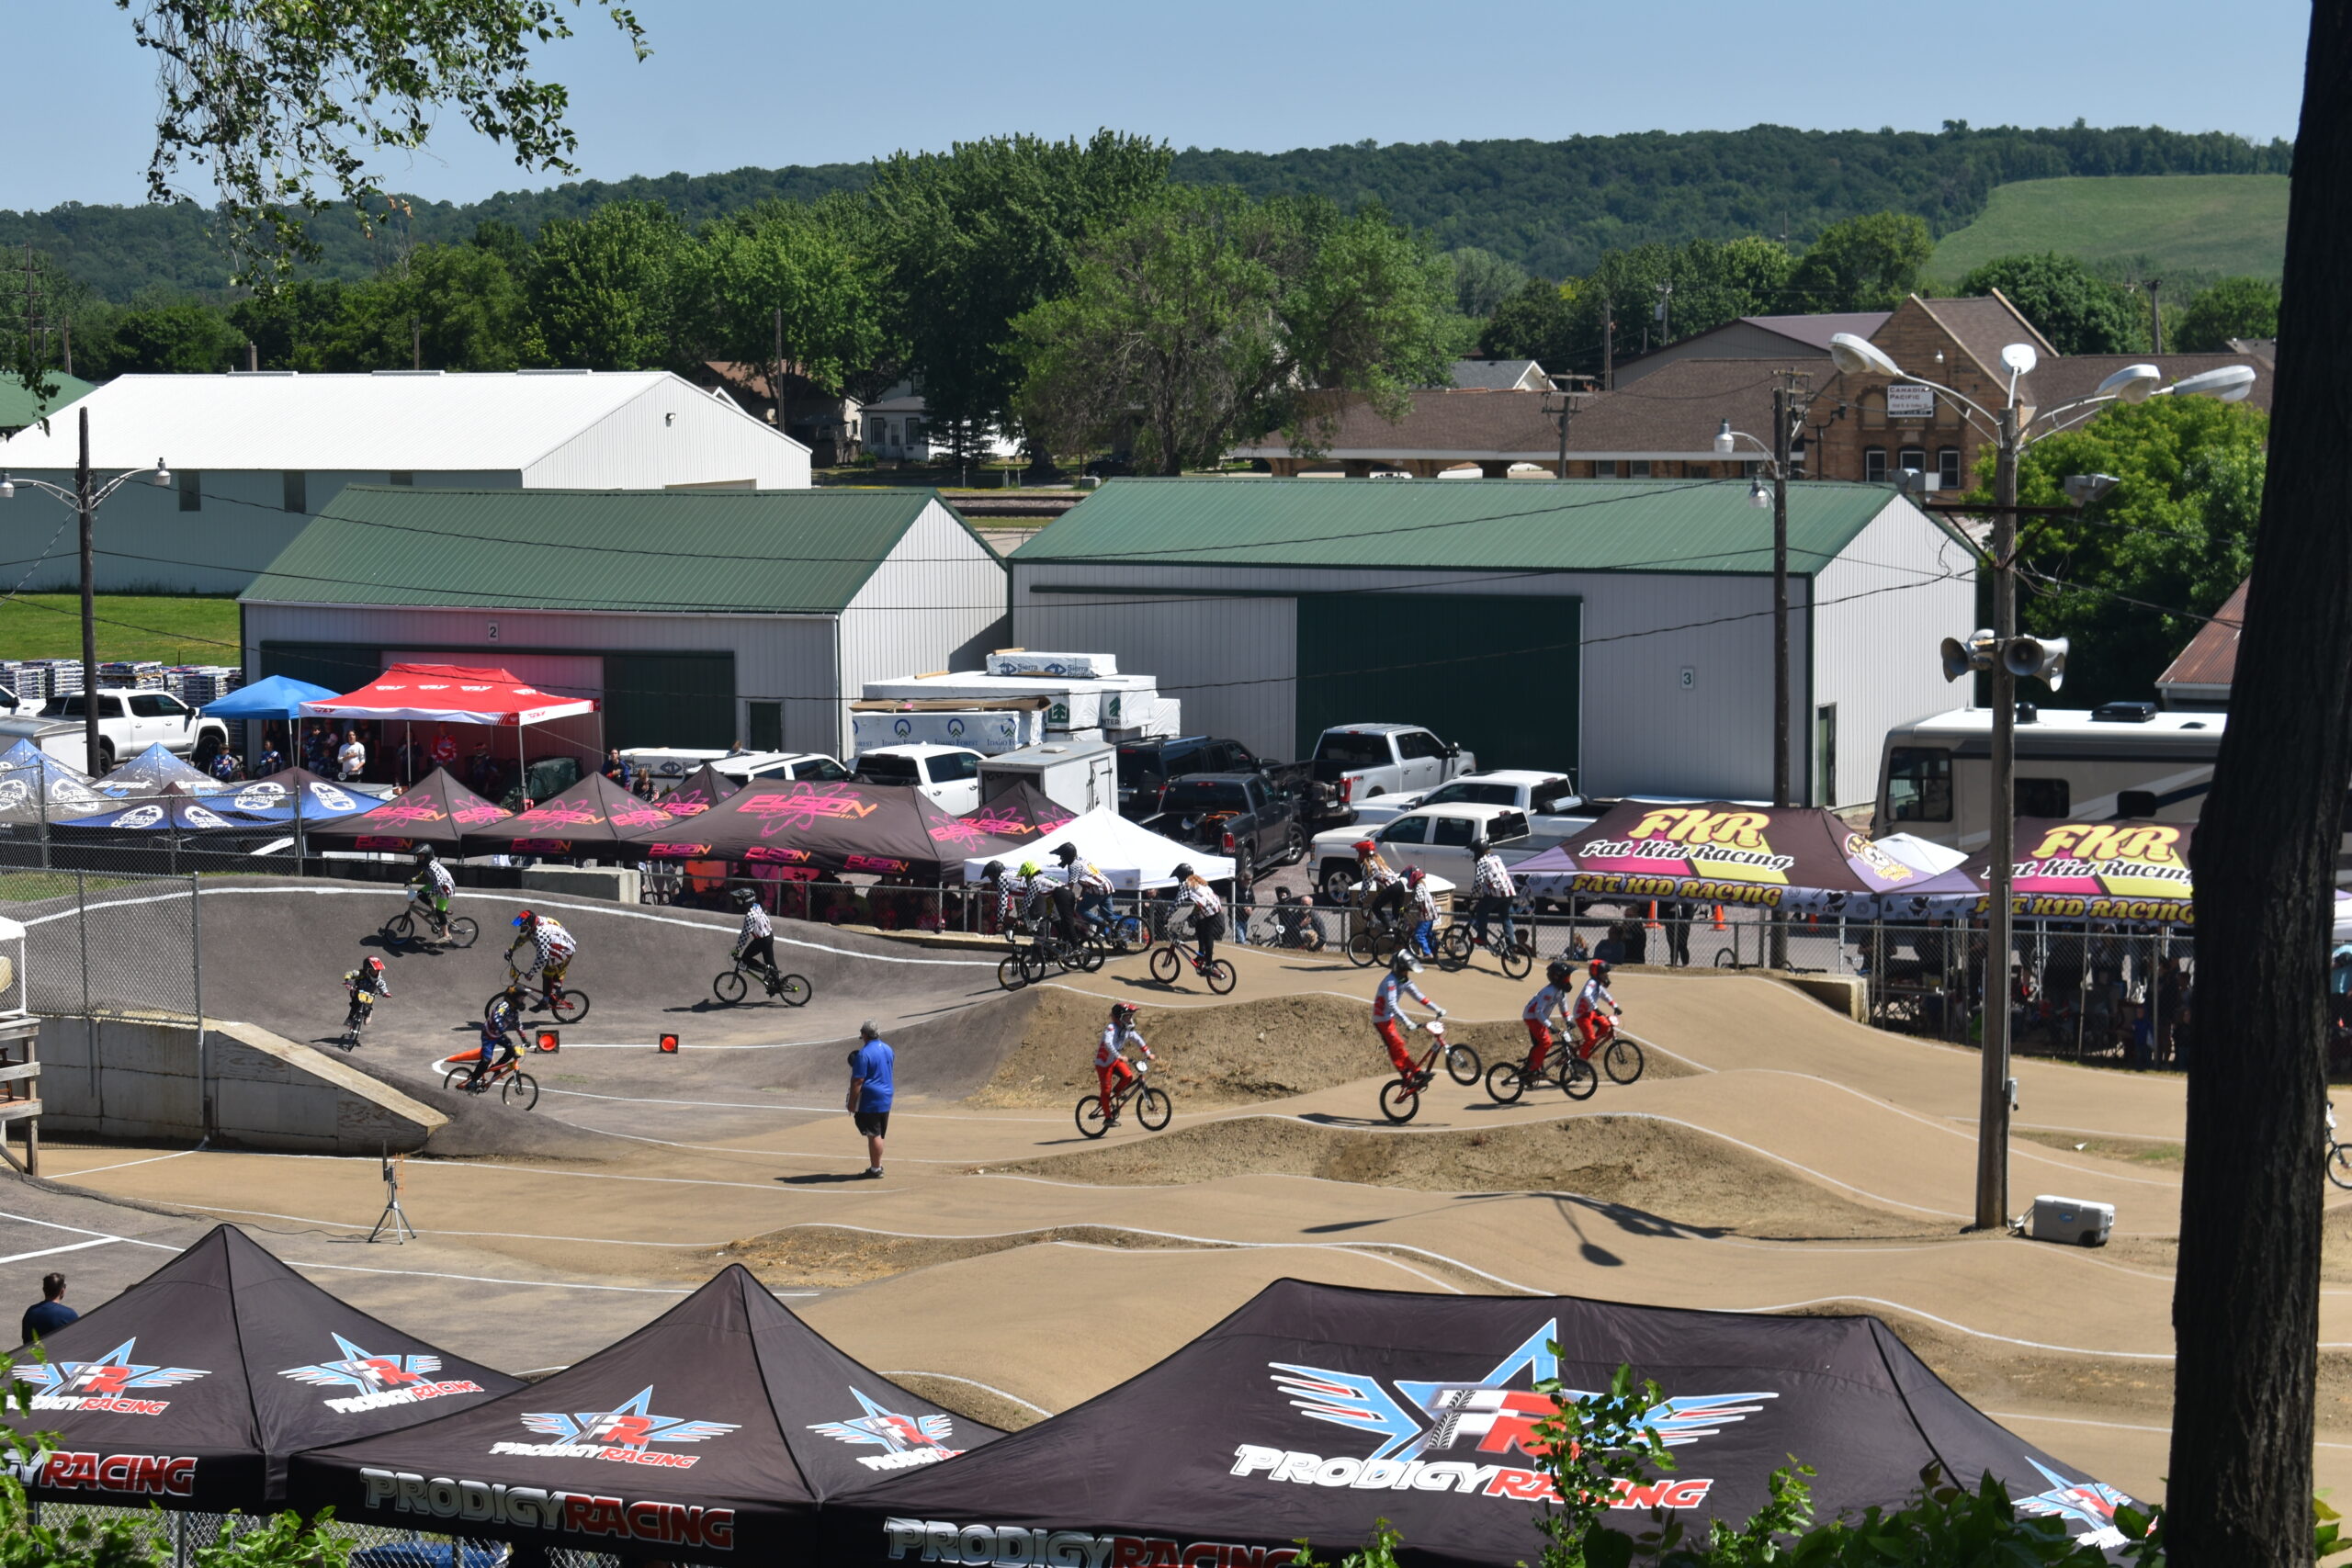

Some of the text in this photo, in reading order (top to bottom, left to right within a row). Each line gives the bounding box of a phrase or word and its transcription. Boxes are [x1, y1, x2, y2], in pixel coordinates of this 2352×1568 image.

[490, 626, 497, 638] 2
[1683, 671, 1692, 685] 3
[737, 794, 878, 820] FUSION
[516, 809, 605, 825] FUSION
[1627, 807, 1770, 847] FKR
[355, 835, 413, 852] FUSION
[510, 838, 571, 854] FUSION
[649, 843, 712, 856] FUSION
[2031, 824, 2180, 862] FKR
[745, 847, 813, 863] FUSION
[844, 854, 910, 872] FUSION
[1578, 839, 1794, 871] Fat Kid Racing
[2037, 857, 2098, 878] Kid
[1572, 874, 1784, 908] FAT KID RACING
[1975, 896, 2029, 915] FT
[2030, 897, 2086, 918] KID
